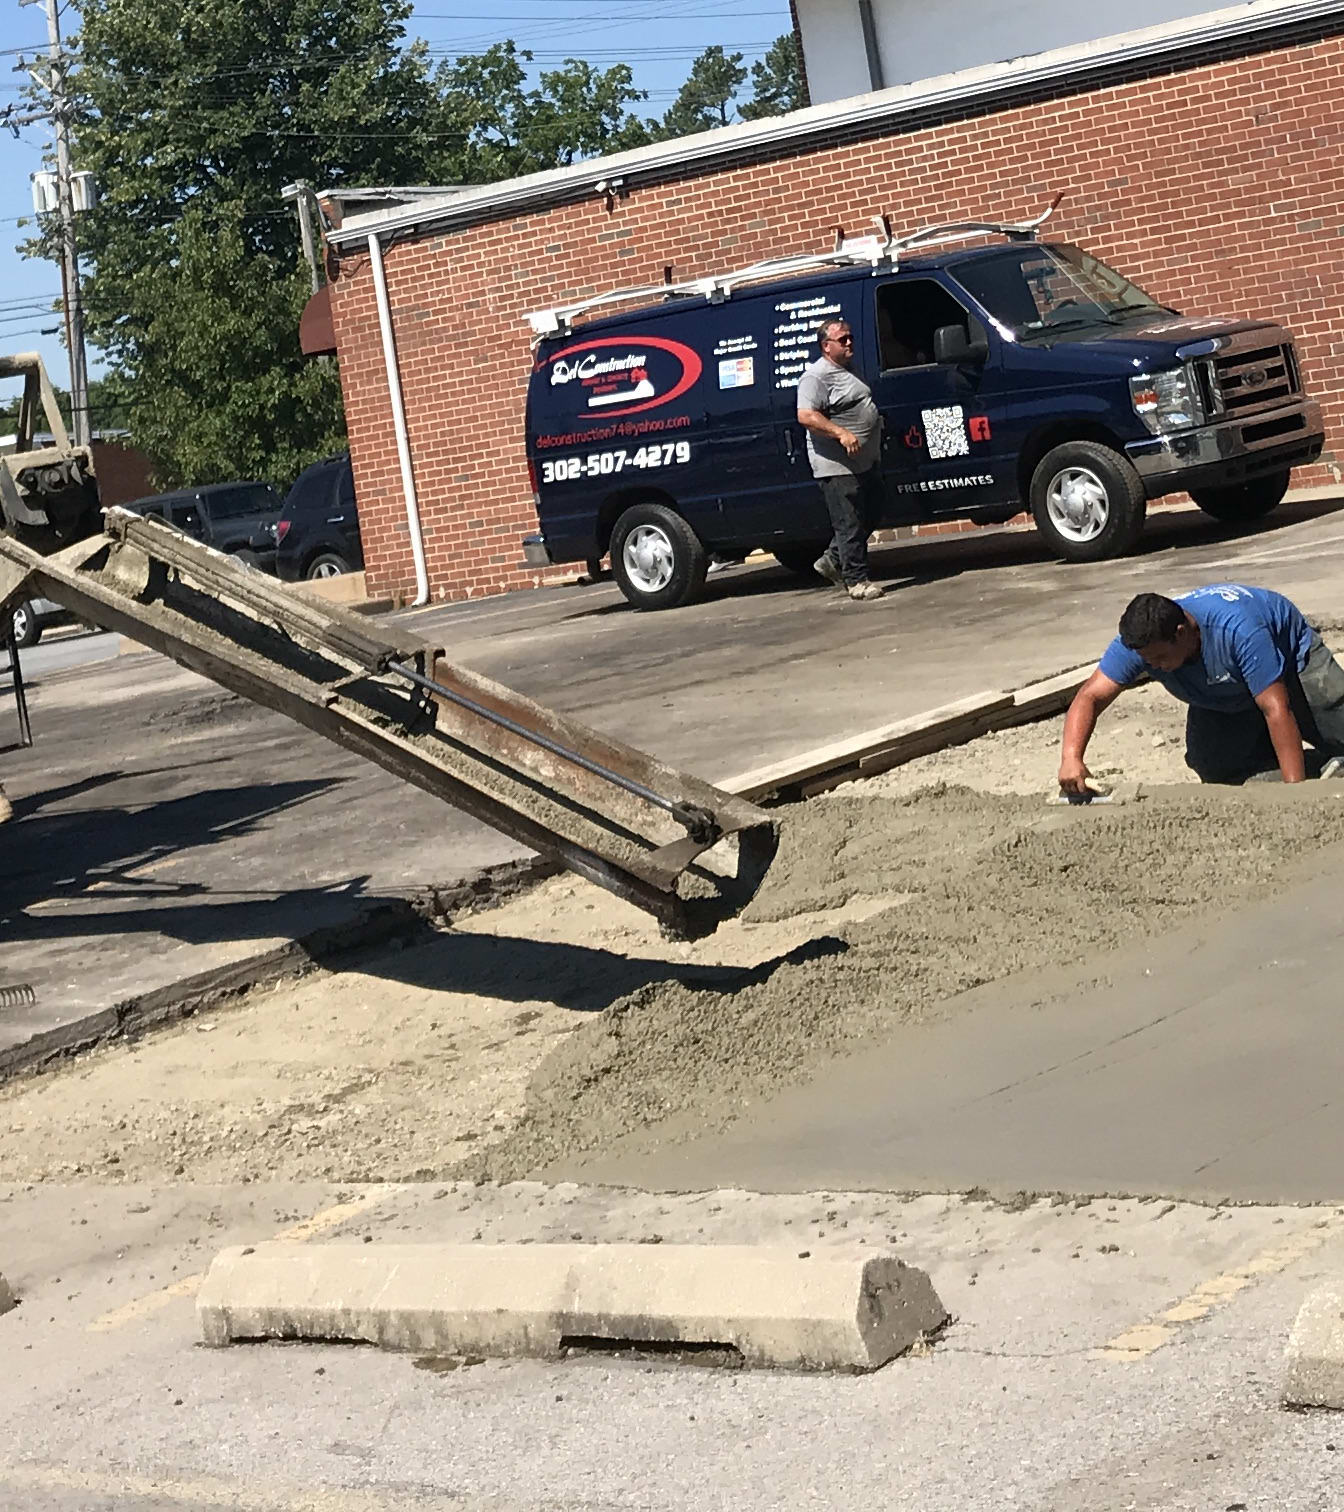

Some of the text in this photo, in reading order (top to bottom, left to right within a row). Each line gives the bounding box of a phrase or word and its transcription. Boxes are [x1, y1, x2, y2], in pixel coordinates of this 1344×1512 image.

[550, 356, 579, 386] Del
[578, 354, 647, 379] Construction
[536, 415, 691, 449] delconstruction74@yahoo.com
[542, 441, 691, 483] 302-507-4279
[897, 475, 994, 493] FREE ESTIMATES
